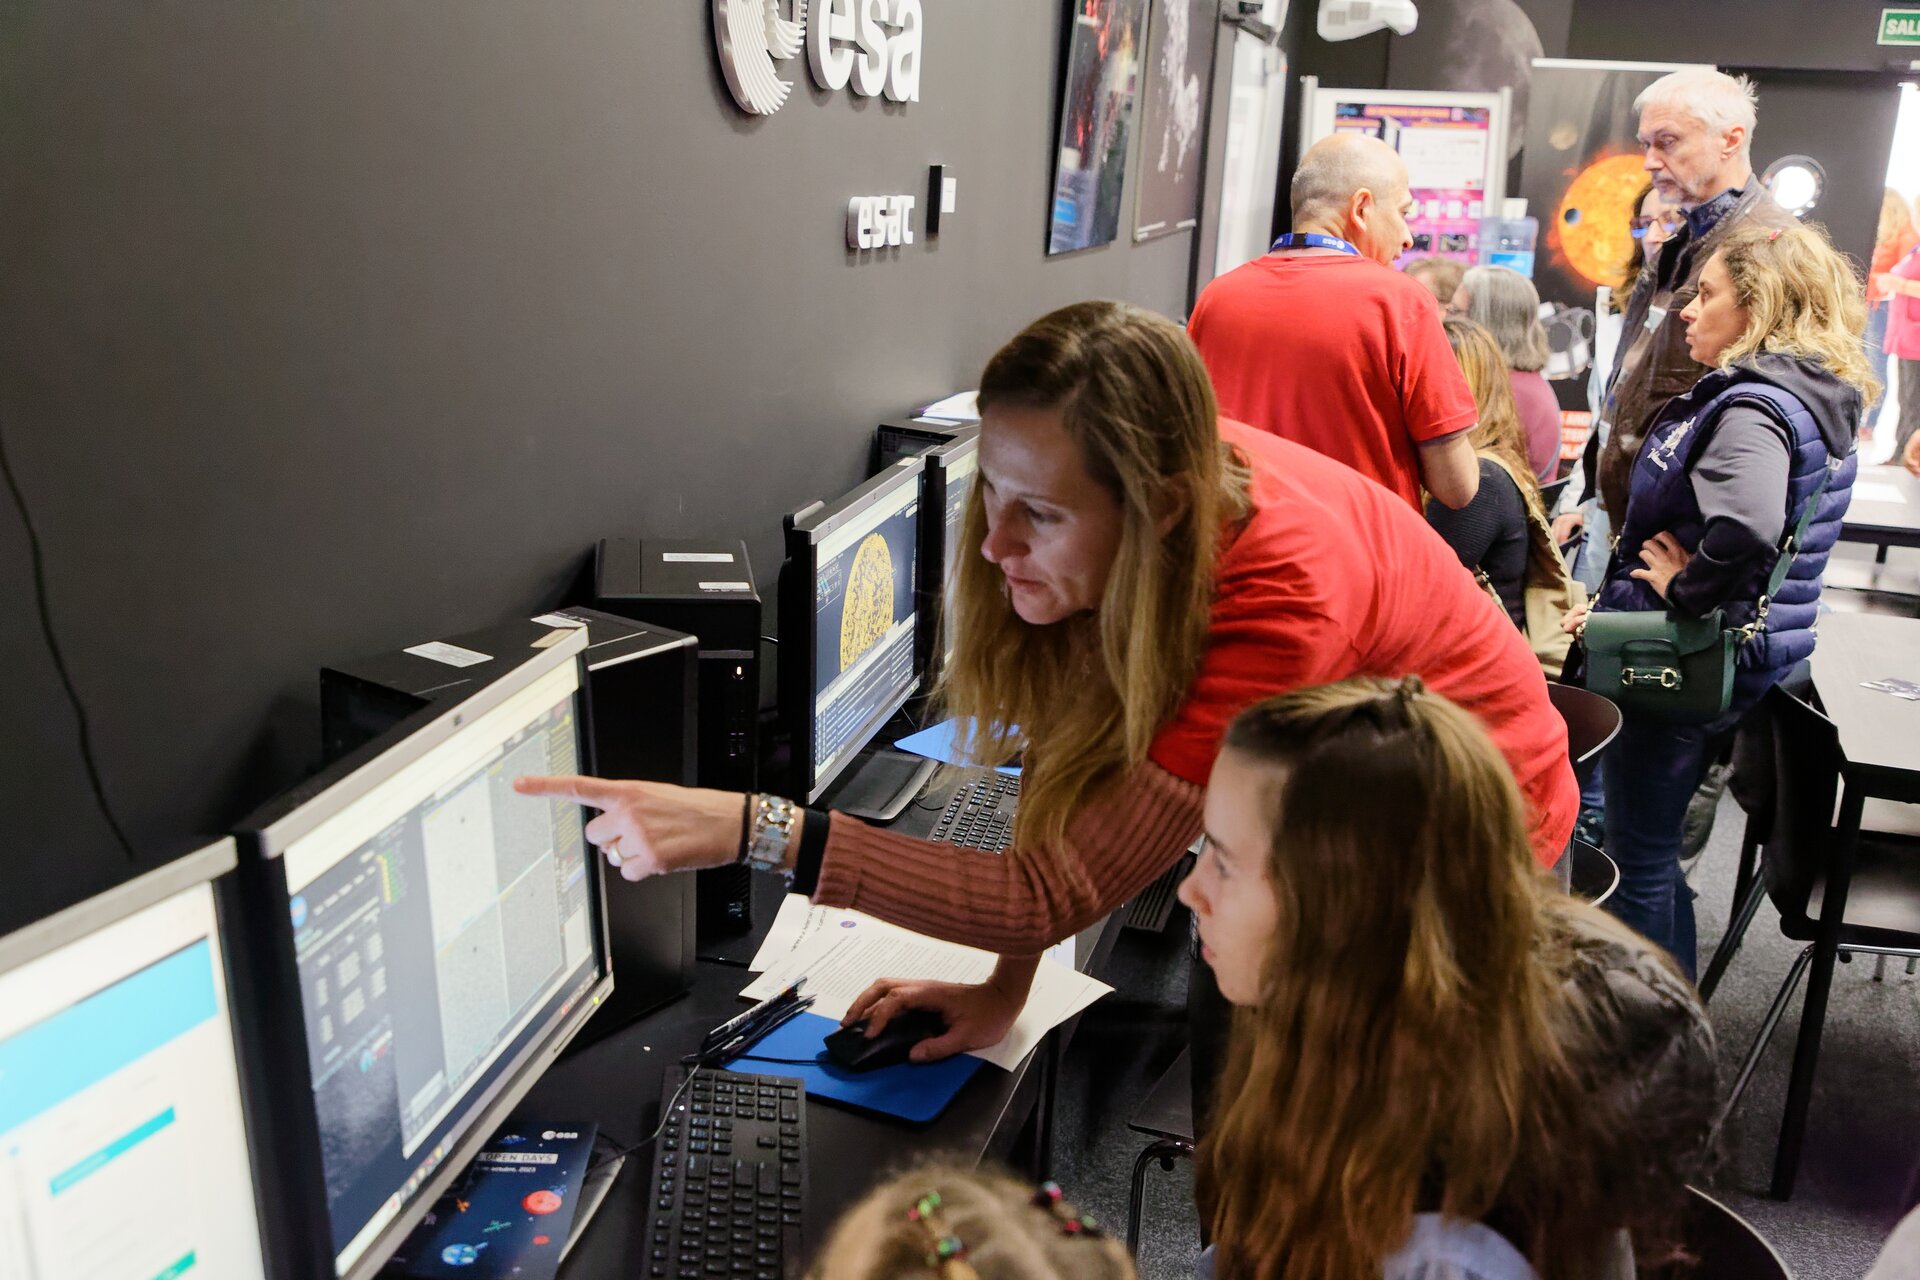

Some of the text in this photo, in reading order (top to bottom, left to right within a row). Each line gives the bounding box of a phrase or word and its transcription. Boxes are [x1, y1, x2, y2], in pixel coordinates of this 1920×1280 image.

[807, 0, 922, 102] esa
[847, 195, 915, 249] esac
[486, 1152, 553, 1162] OPEN DAYS
